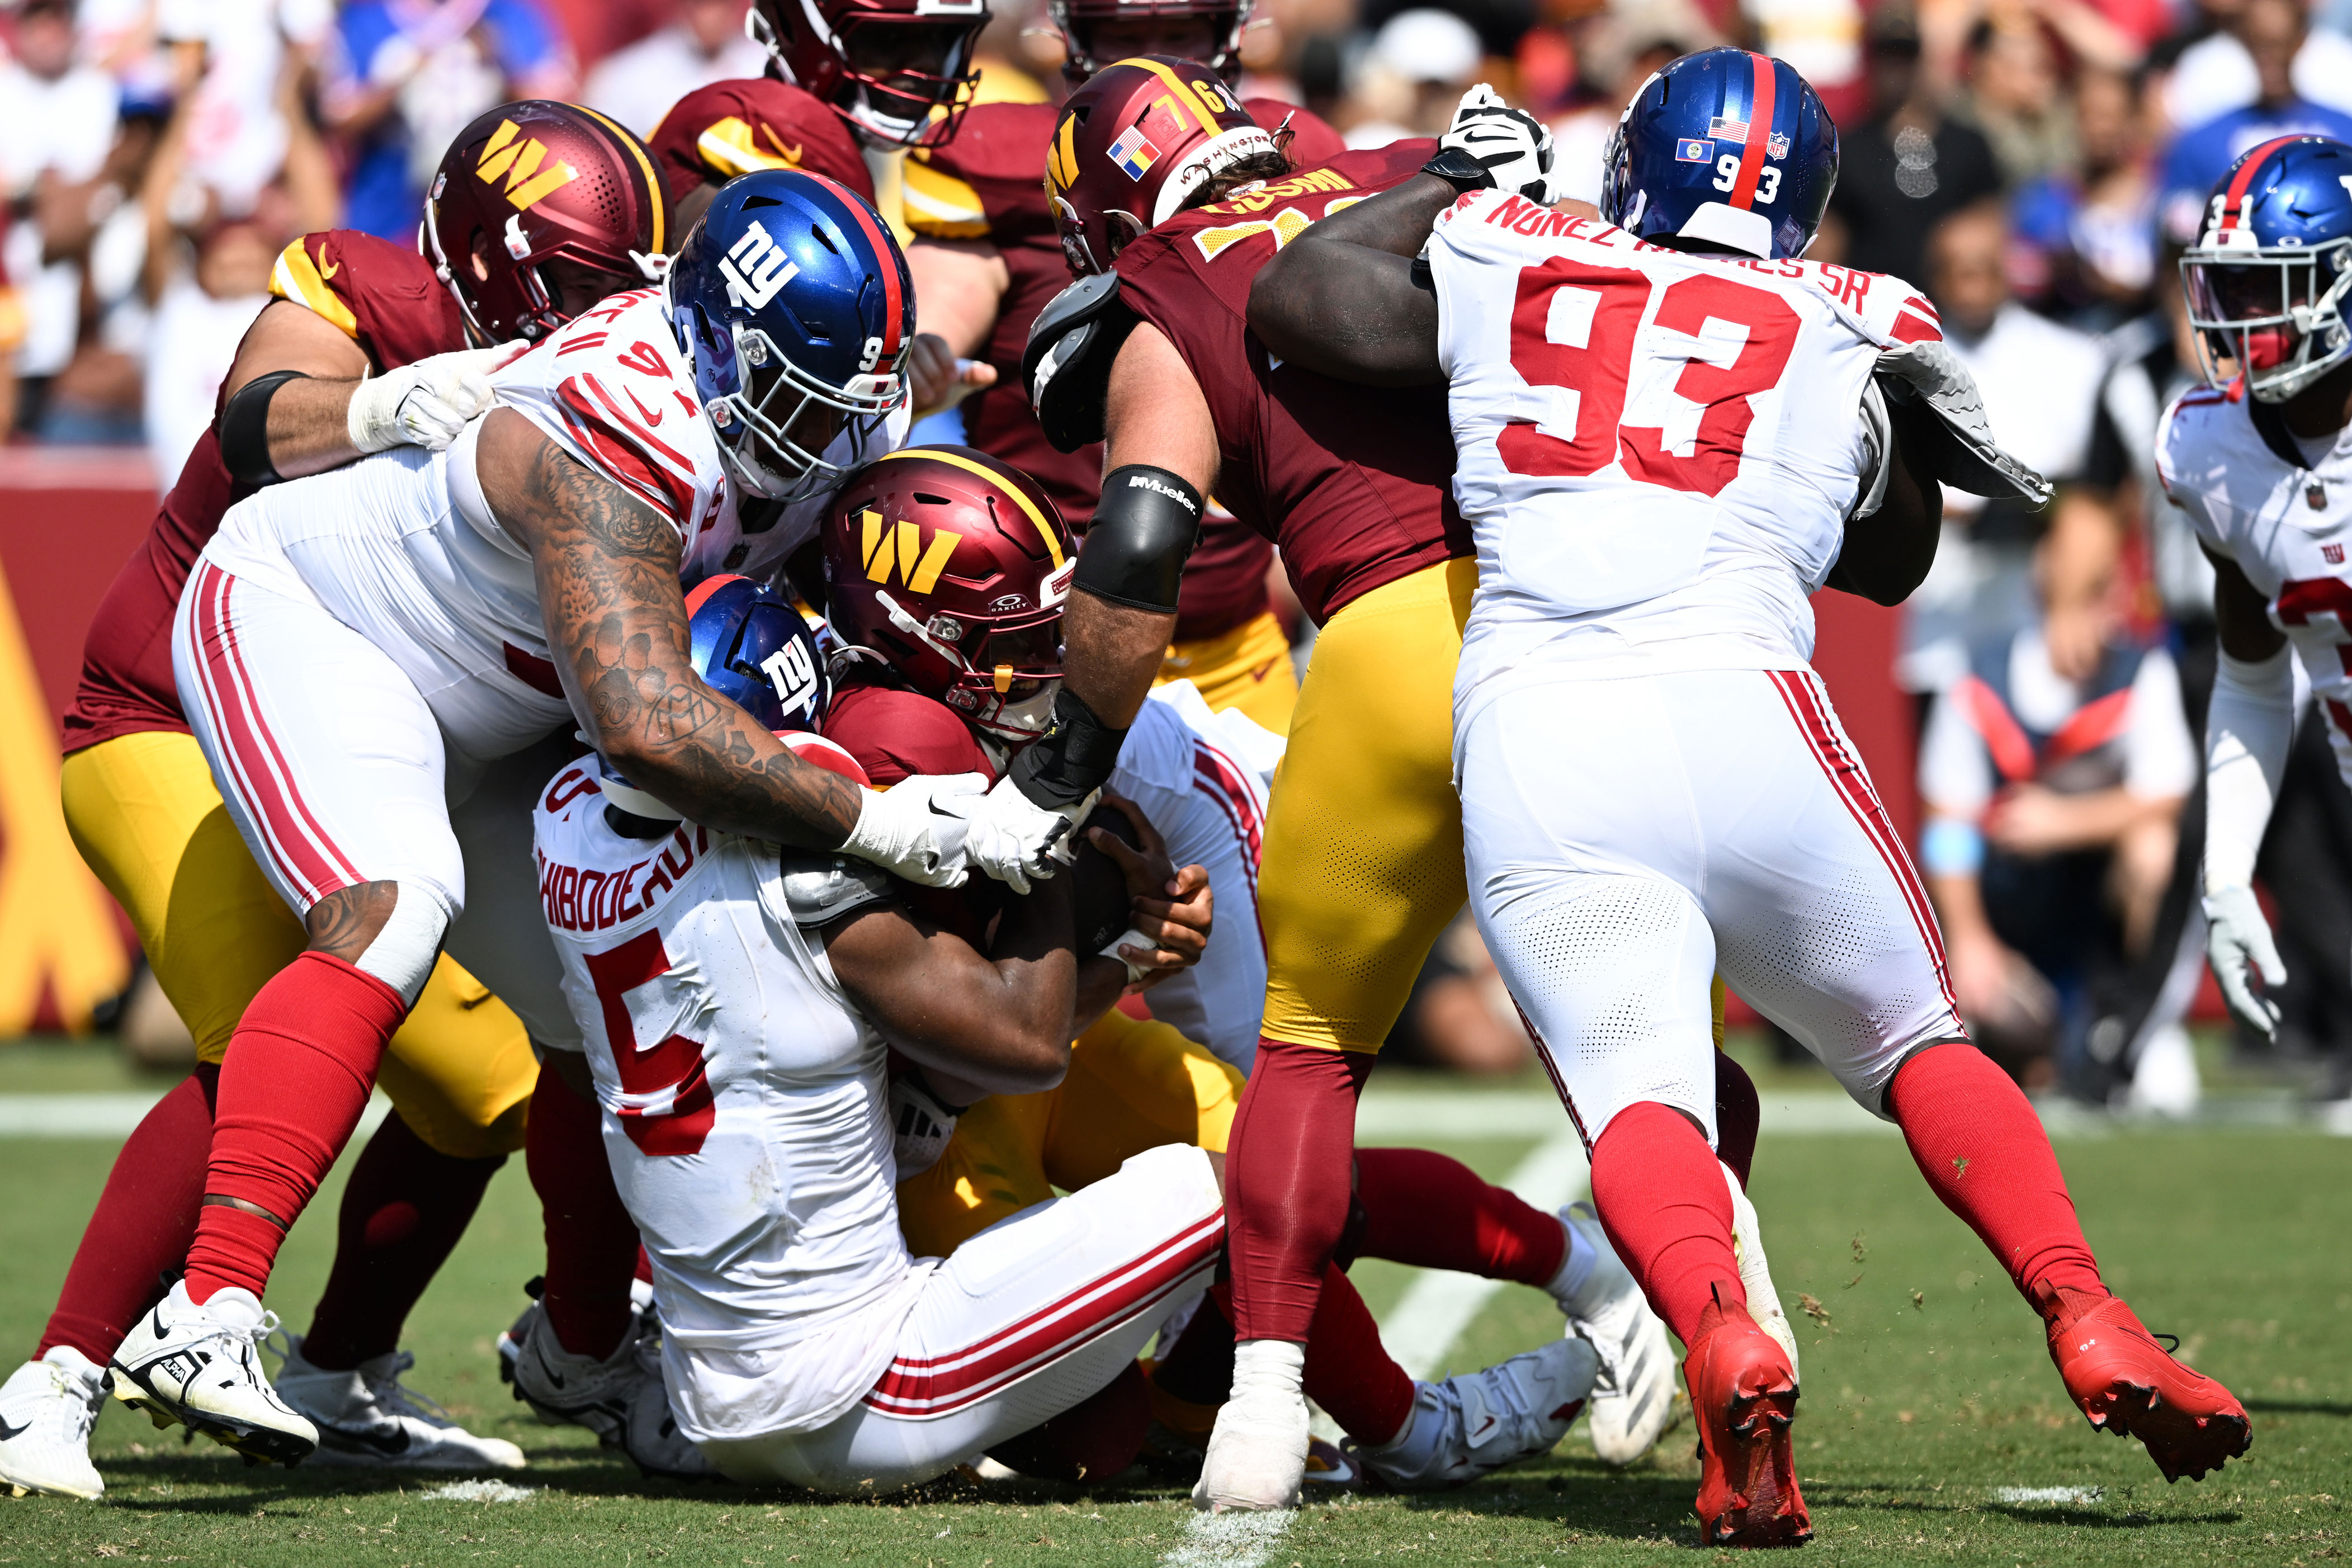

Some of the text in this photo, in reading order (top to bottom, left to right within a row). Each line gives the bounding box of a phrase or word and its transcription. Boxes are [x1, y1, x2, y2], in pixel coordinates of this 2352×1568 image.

[1152, 80, 1226, 132] 76
[1180, 135, 1269, 185] WASHINGTON
[1769, 142, 1784, 156] NFL
[1712, 154, 1782, 204] 93
[2208, 194, 2254, 230] 31
[1818, 262, 1871, 316] SR
[858, 336, 911, 371] 97
[1496, 255, 1802, 497] 93
[991, 602, 1027, 612] OAKLEY
[538, 824, 725, 932] HIBODEAU
[584, 927, 715, 1156] 5
[161, 1359, 185, 1381] ALPHA
